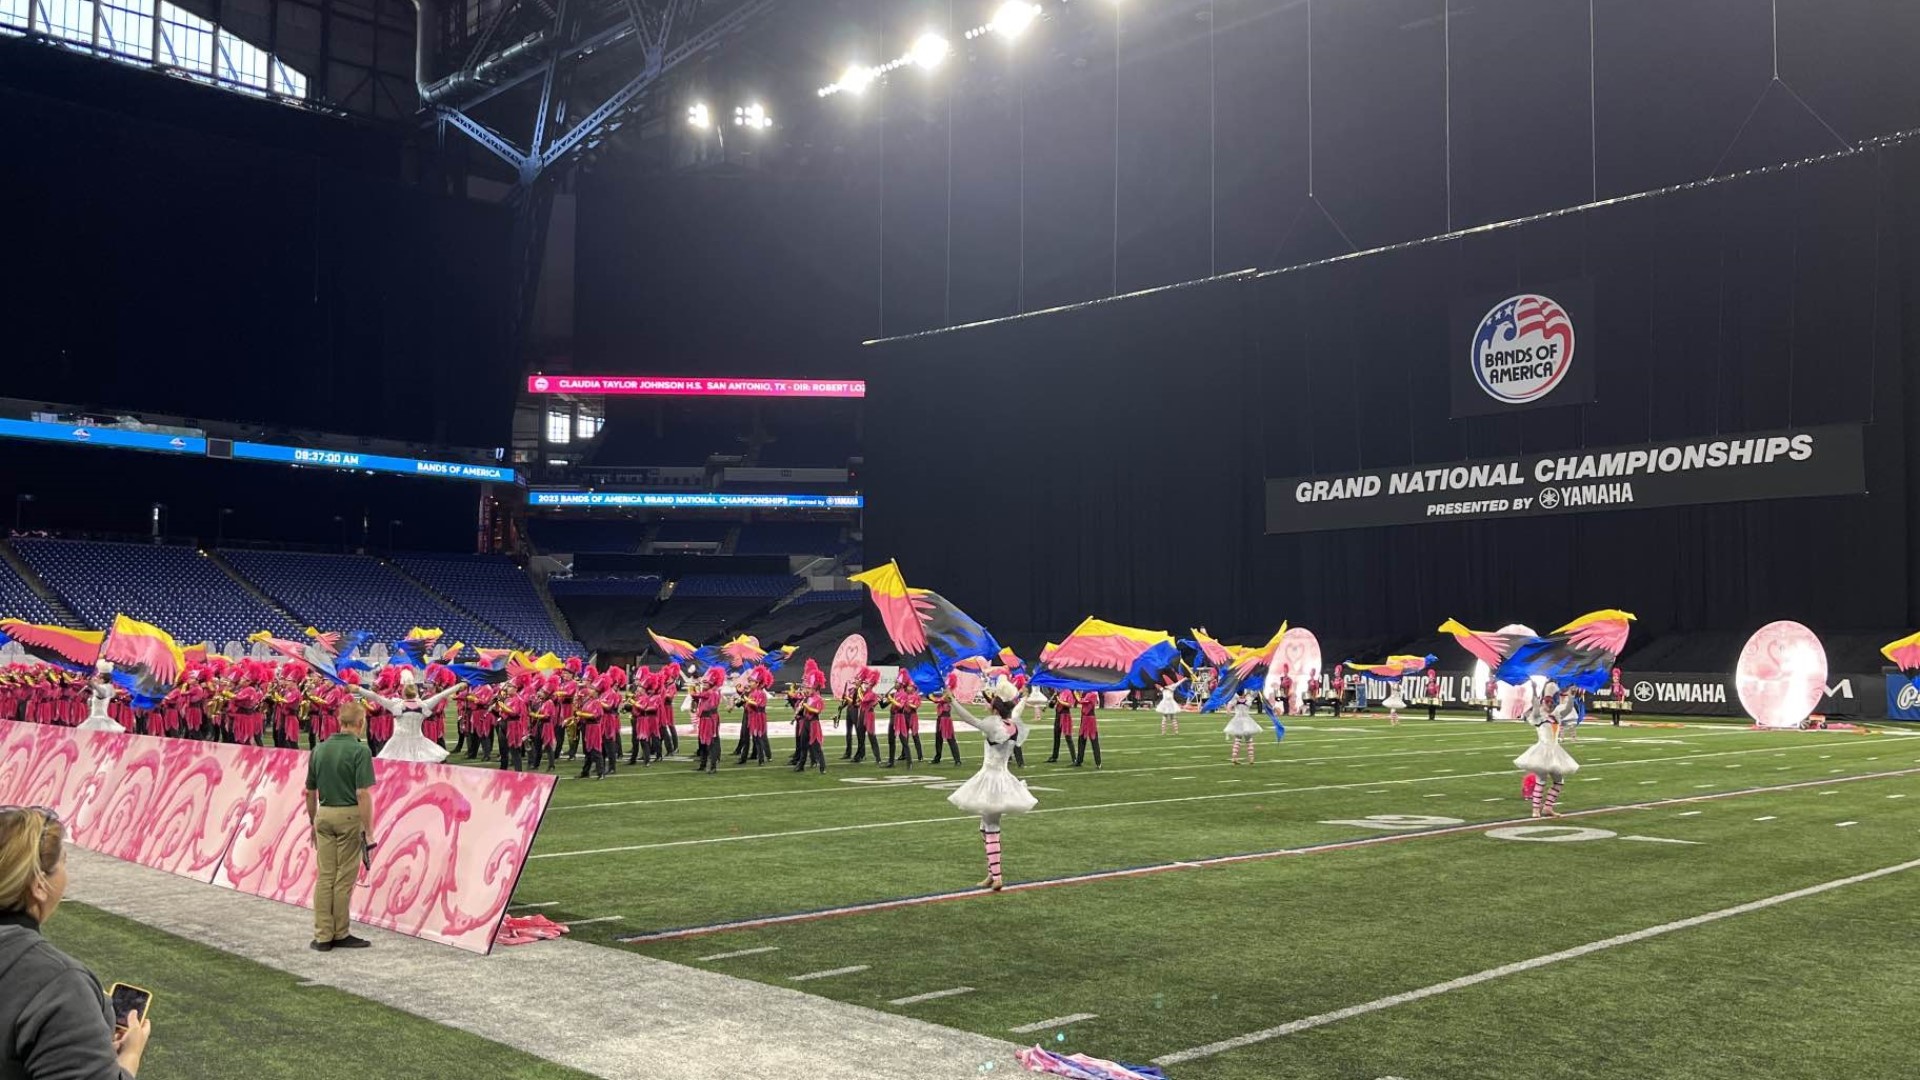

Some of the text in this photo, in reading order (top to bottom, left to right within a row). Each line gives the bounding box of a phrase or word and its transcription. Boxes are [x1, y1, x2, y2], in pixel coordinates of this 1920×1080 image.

[1485, 344, 1557, 368] BANDS OF
[1490, 361, 1553, 384] AMERICA
[559, 379, 600, 389] CLAUDIA
[602, 380, 638, 389] TAYLOR
[639, 380, 684, 390] JOHNSON
[706, 382, 726, 391] SAN
[727, 382, 773, 392] ANTONIO,
[774, 382, 786, 391] TX
[813, 383, 848, 392] ROBERT
[295, 450, 359, 465] 08:37:00 AM
[417, 462, 501, 478] BANDS OF AMERICA
[1296, 433, 1814, 503] GRAND NATIONAL CHAMPIONSHIPS
[538, 495, 559, 503] 2023
[560, 495, 590, 503] BANDS
[591, 495, 602, 503] OF
[604, 496, 642, 504] AMERICA
[644, 496, 674, 504] GRAND
[676, 496, 717, 505] NATIONAL
[719, 497, 788, 505] CHAMPIONSHIPS
[1427, 482, 1634, 516] PRESENTED BY YAMAHA
[1655, 683, 1726, 703] YAMAHA
